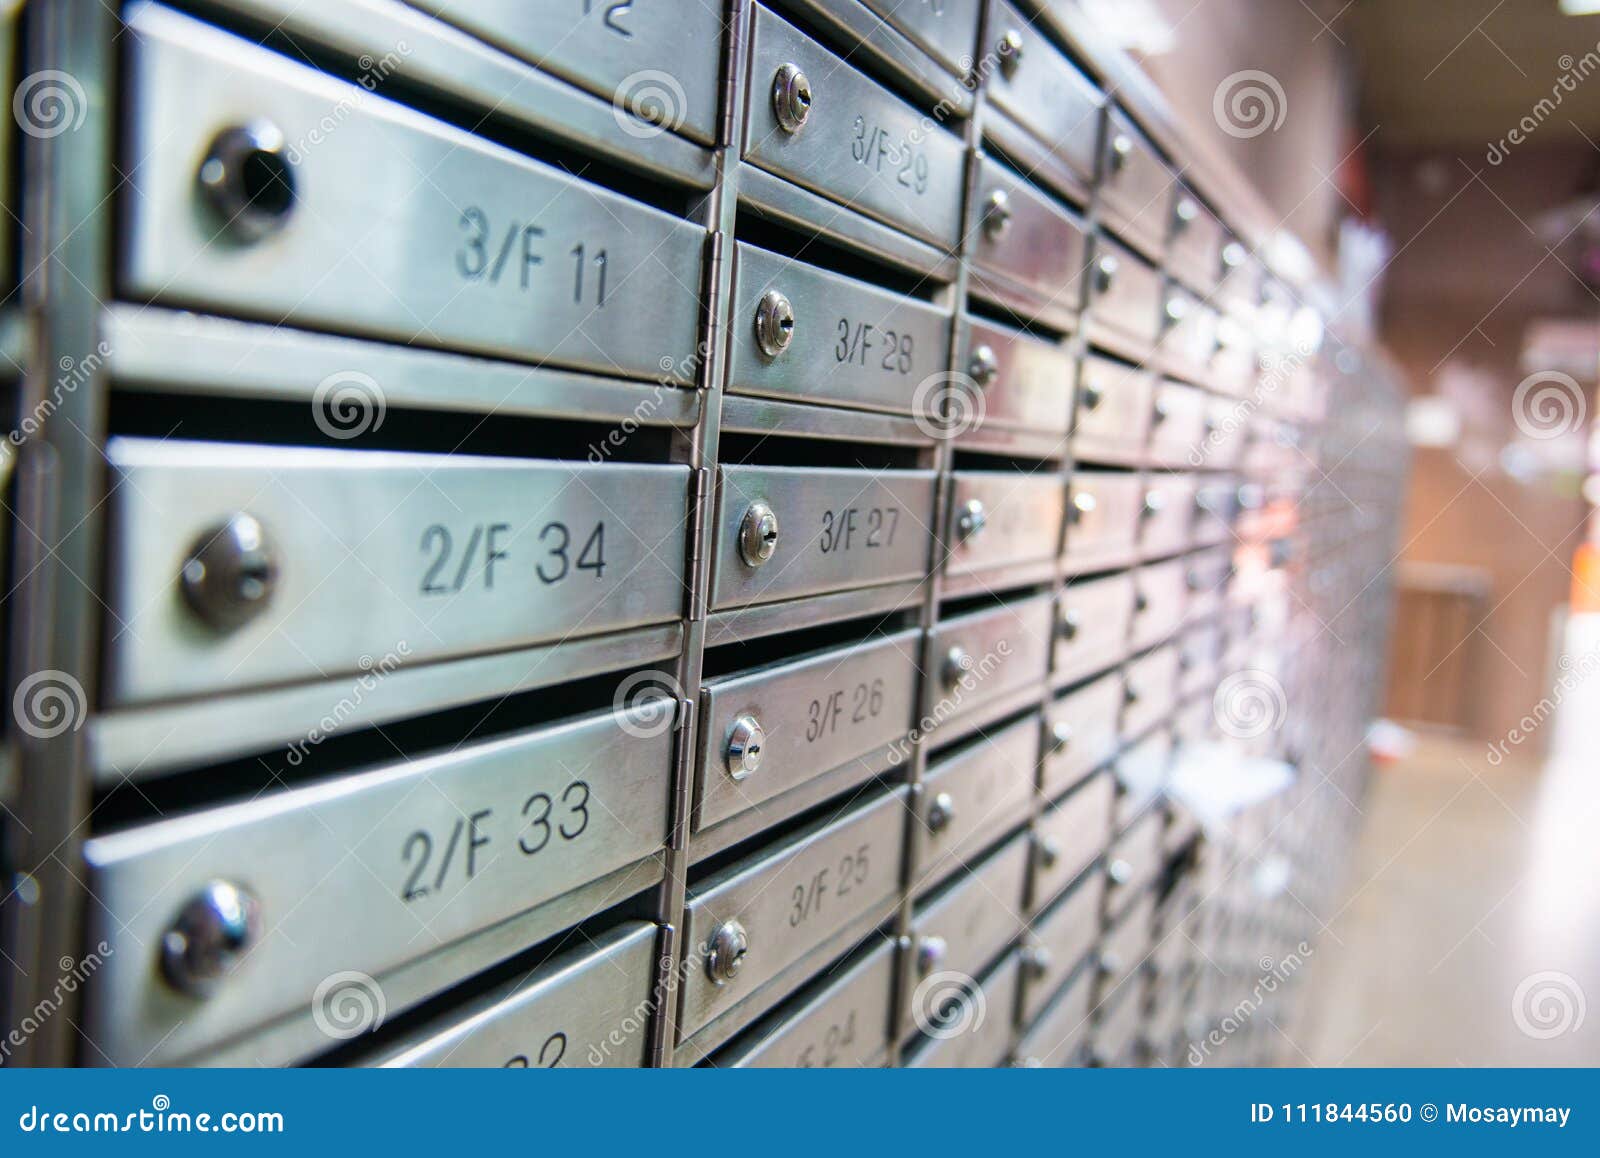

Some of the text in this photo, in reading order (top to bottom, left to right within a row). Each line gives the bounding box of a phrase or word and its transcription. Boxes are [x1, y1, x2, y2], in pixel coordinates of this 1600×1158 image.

[851, 114, 929, 194] 3/F 29
[455, 206, 609, 309] 3/F 11
[835, 317, 914, 375] 3/F 28
[420, 520, 607, 595] 2/F 34
[820, 507, 898, 553] 3/F 27
[806, 678, 885, 743] 3/F 26
[402, 780, 591, 902] 2/F 33
[789, 846, 870, 928] 3/F 25
